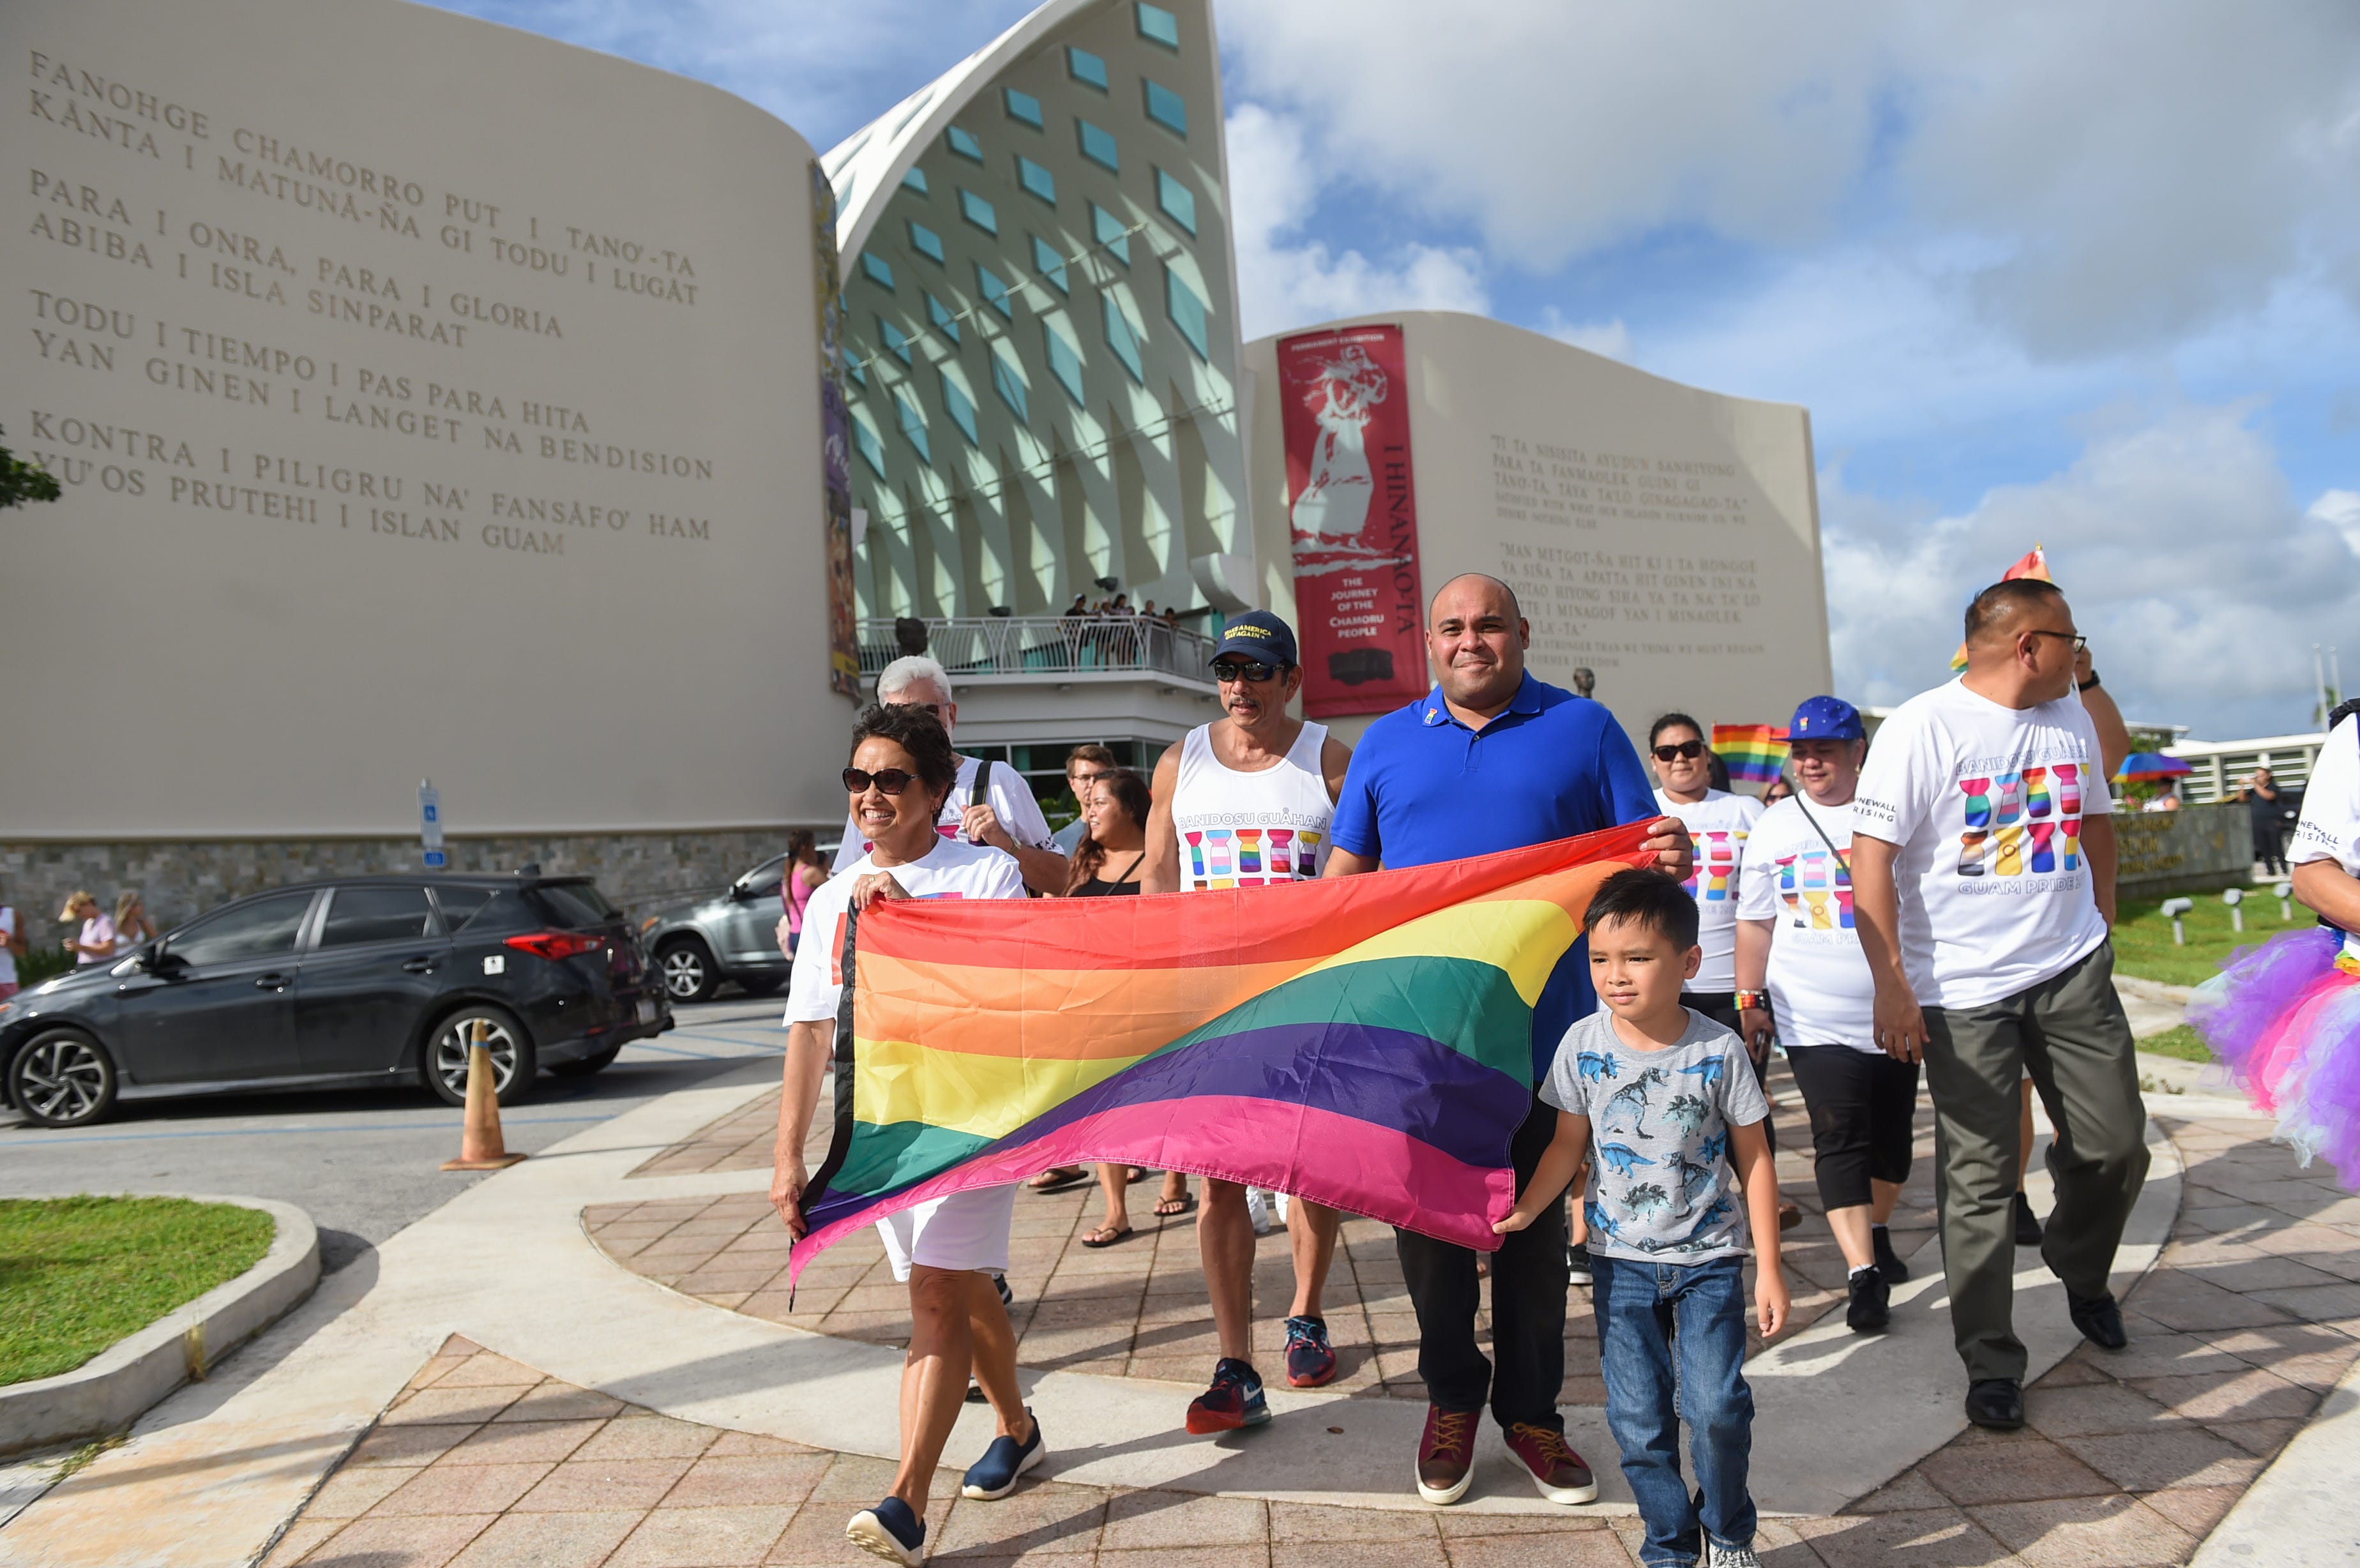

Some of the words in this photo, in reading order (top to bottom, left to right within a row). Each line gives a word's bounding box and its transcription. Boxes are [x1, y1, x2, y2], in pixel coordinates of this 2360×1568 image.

[30, 50, 209, 140] FANOHGE
[234, 128, 424, 206] CHAMORRO
[446, 193, 501, 228] PUT
[531, 216, 538, 239] I
[30, 89, 160, 160] KANTA
[185, 144, 193, 170] I
[441, 225, 472, 253] GI
[490, 236, 568, 277] TODU
[588, 261, 594, 283] I
[30, 168, 132, 226] PARA
[158, 209, 166, 236] I
[190, 222, 297, 276] ONRA,
[319, 257, 401, 301] PARA
[423, 285, 430, 308] I
[450, 292, 563, 338] GLORIA
[30, 212, 153, 270] ABIBA
[179, 253, 187, 279] I
[211, 262, 287, 305] ISLA
[307, 289, 467, 348] SINPARAT
[30, 289, 133, 340] TODU
[158, 321, 166, 348] I
[181, 328, 316, 381] TIEMPO
[331, 362, 338, 387] I
[359, 368, 412, 401] PAS
[428, 383, 506, 419] PARA
[522, 400, 589, 433] HITA
[31, 329, 114, 372] YAN
[146, 358, 269, 405] GINEN
[292, 388, 300, 414] I
[326, 395, 461, 443] LANGET
[485, 426, 522, 455] NA
[540, 435, 712, 480] BENDISION
[1492, 453, 1524, 471] PARA
[1530, 459, 1544, 475] TA
[31, 410, 196, 468] KONTRA
[222, 448, 229, 473] I
[255, 454, 403, 501] PILIGRU
[423, 481, 469, 511] NA'
[649, 513, 710, 540] HAM
[170, 475, 317, 524] PRUTEHI
[340, 504, 348, 529] I
[371, 508, 460, 542] ISLAN
[481, 524, 564, 555] GUAM
[1619, 554, 1641, 568] HIT
[1677, 557, 1694, 571] TA
[1342, 577, 1363, 587] THE
[1501, 560, 1517, 575] YA
[1559, 566, 1573, 581] TA
[1635, 573, 1657, 587] HIT
[1663, 574, 1706, 589] GINEN
[1737, 577, 1757, 590] NA
[1331, 588, 1379, 601] JOURNEY
[1608, 590, 1640, 603] SIHA
[1648, 591, 1665, 605] YA
[1672, 592, 1689, 606] TA
[1338, 603, 1352, 612] OF
[1354, 600, 1373, 610] THE
[1624, 608, 1649, 621] YAN
[1236, 630, 1260, 638] AGAIN
[1239, 624, 1272, 637] AMERICA
[1338, 626, 1377, 638] PEOPLE
[1956, 750, 2036, 776] BANIDOSU
[1853, 806, 1894, 822] RISING
[1857, 797, 1896, 813] NEWALL
[1179, 813, 1255, 829] BANIDOSU
[2299, 820, 2338, 845] NEWALL
[1958, 881, 2021, 895] GUAM
[2026, 877, 2075, 894] PRIDE
